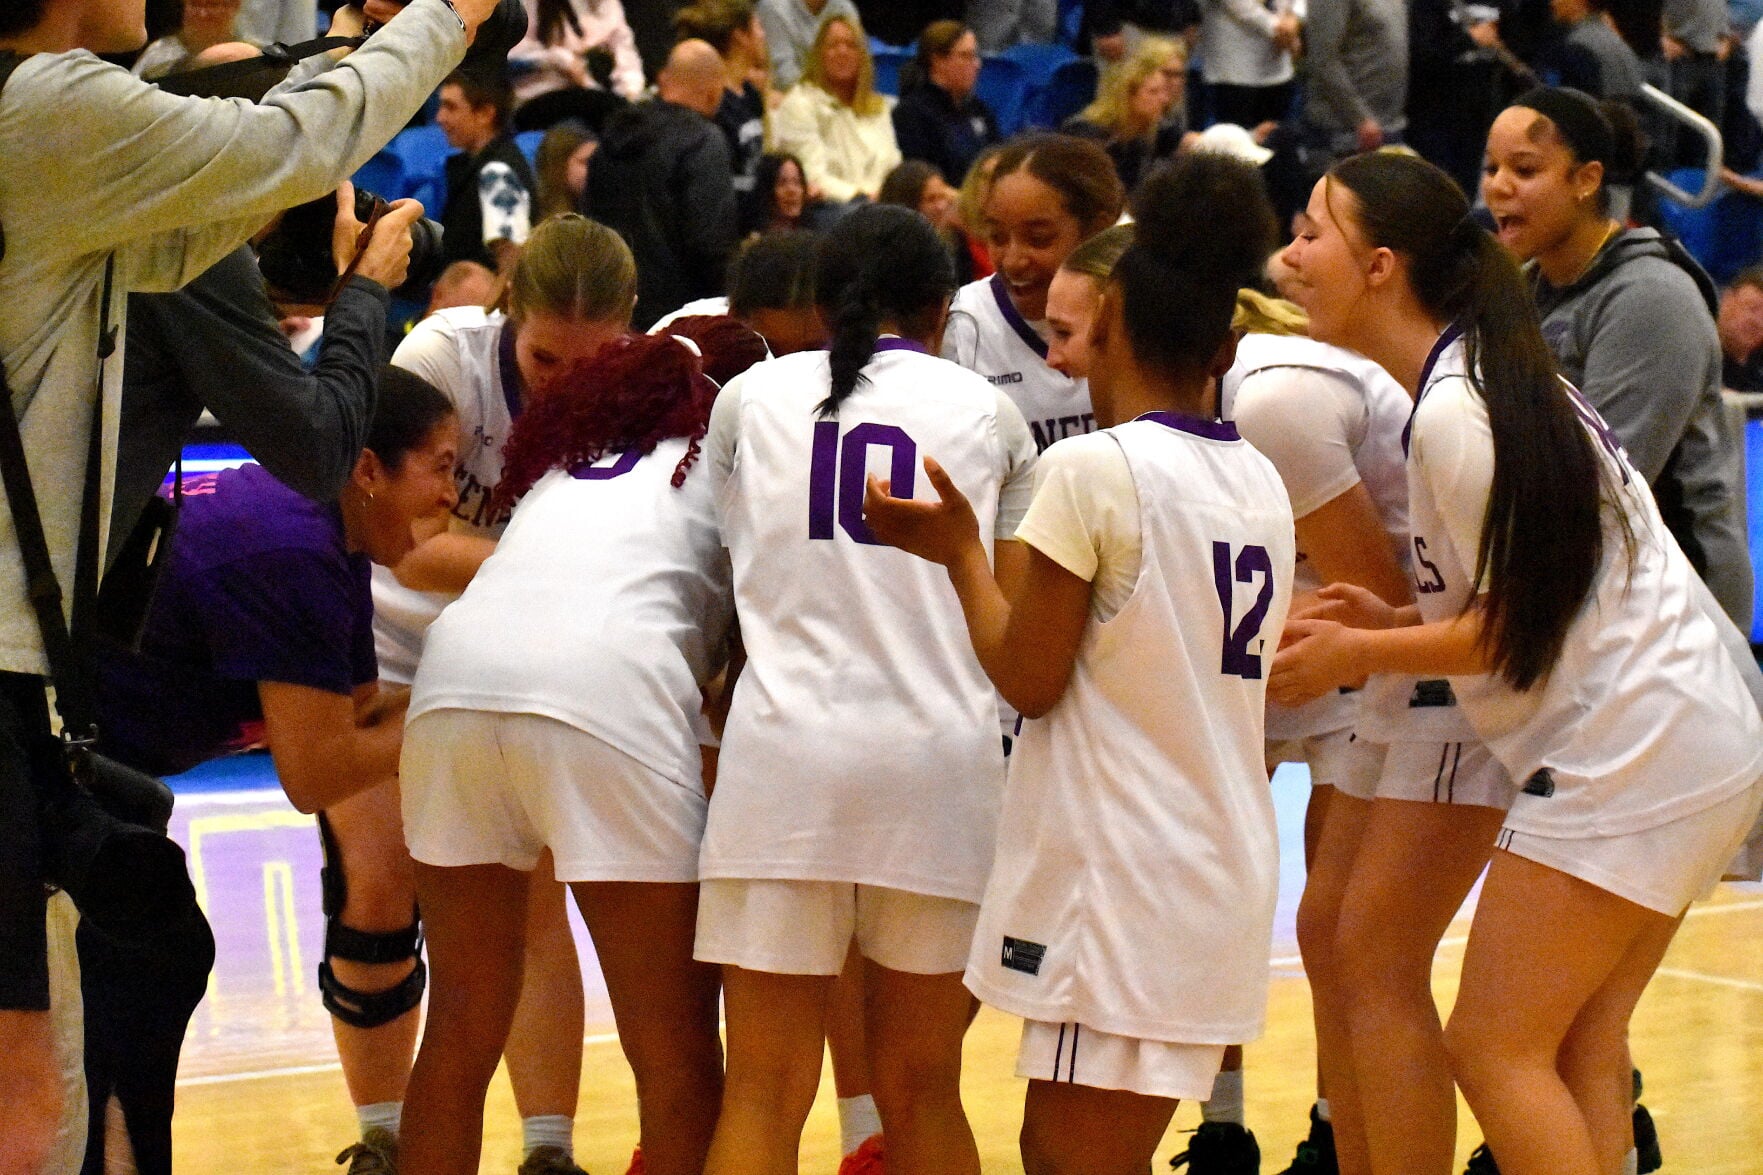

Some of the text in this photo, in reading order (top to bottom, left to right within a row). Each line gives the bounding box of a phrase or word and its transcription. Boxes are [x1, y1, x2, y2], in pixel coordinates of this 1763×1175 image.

[808, 421, 917, 547] 10
[1212, 541, 1274, 680] 12
[1003, 945, 1013, 961] M
